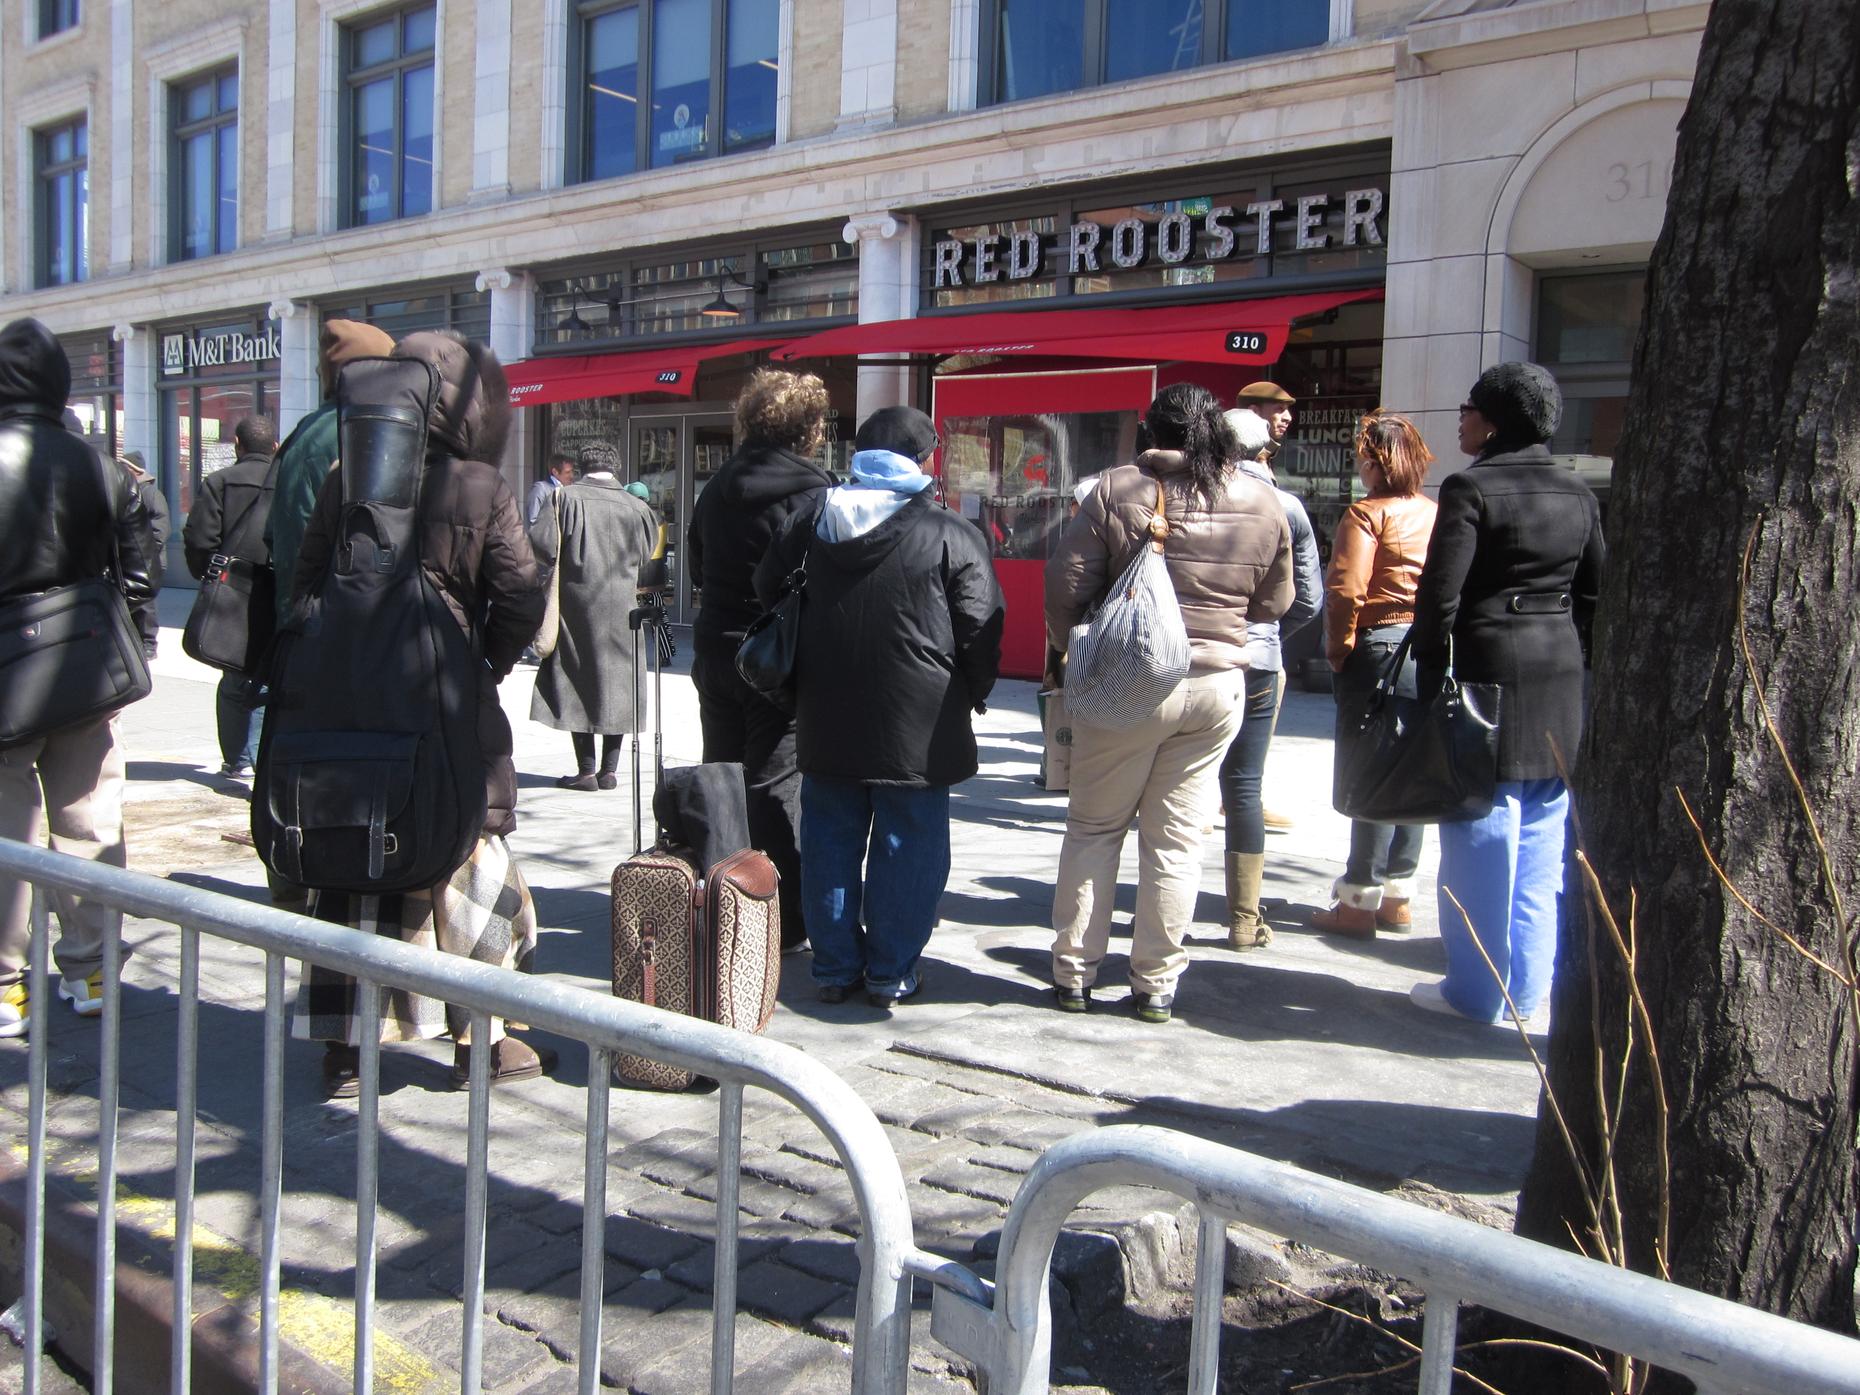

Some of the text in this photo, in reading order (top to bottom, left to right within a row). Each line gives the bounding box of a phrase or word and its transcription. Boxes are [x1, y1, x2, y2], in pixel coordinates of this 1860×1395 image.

[935, 187, 1384, 288] RED ROOSTER
[188, 326, 281, 367] M&T Bank
[1232, 336, 1259, 350] 310
[659, 372, 677, 382] 310
[510, 384, 544, 395] ROOSTER
[1297, 427, 1355, 444] LUNC
[1296, 445, 1356, 474] DINNE
